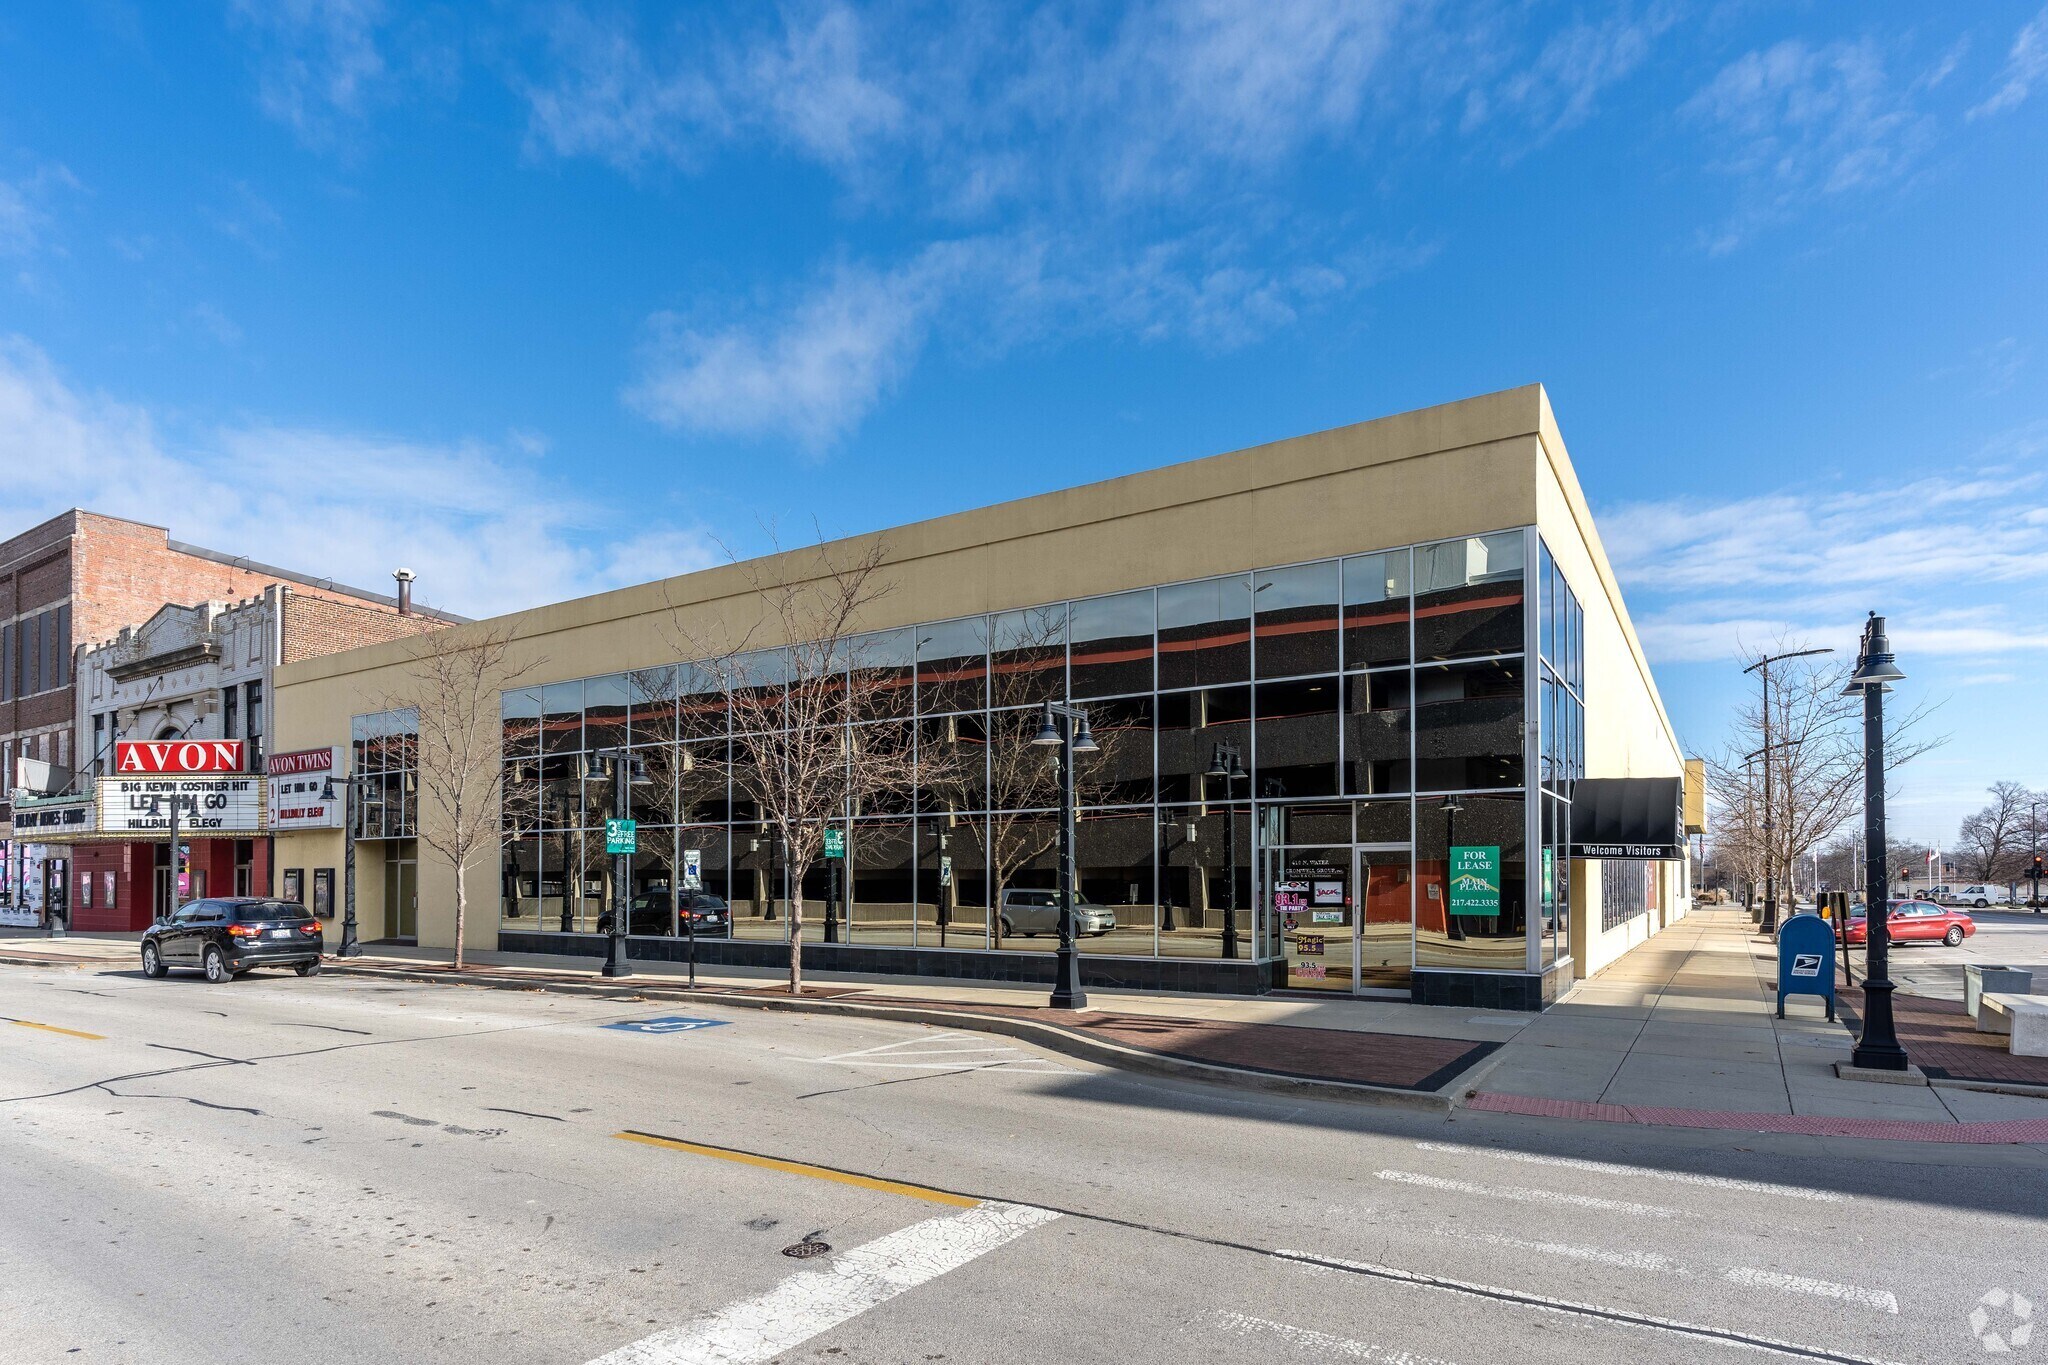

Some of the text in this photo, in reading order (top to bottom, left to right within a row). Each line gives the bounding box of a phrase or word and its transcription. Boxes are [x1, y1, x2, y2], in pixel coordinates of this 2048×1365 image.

[119, 743, 239, 771] AVON
[270, 751, 331, 773] AVON TWINS
[121, 781, 249, 792] BIG KEVIN COSTNER HIT
[270, 783, 275, 798] 1
[281, 784, 291, 794] LET
[309, 781, 318, 792] GO
[205, 793, 227, 810] GO
[270, 808, 275, 824] 2
[189, 817, 223, 828] ELEGY
[607, 821, 617, 837] 3
[1463, 851, 1486, 860] FOR
[1582, 845, 1661, 855] Welcome Visitors
[1457, 861, 1492, 870] LEASE
[1275, 893, 1298, 906] 93.1
[1451, 899, 1499, 907] 217.422.3335
[1298, 936, 1323, 944] Magic
[1300, 961, 1316, 969] 93.5
